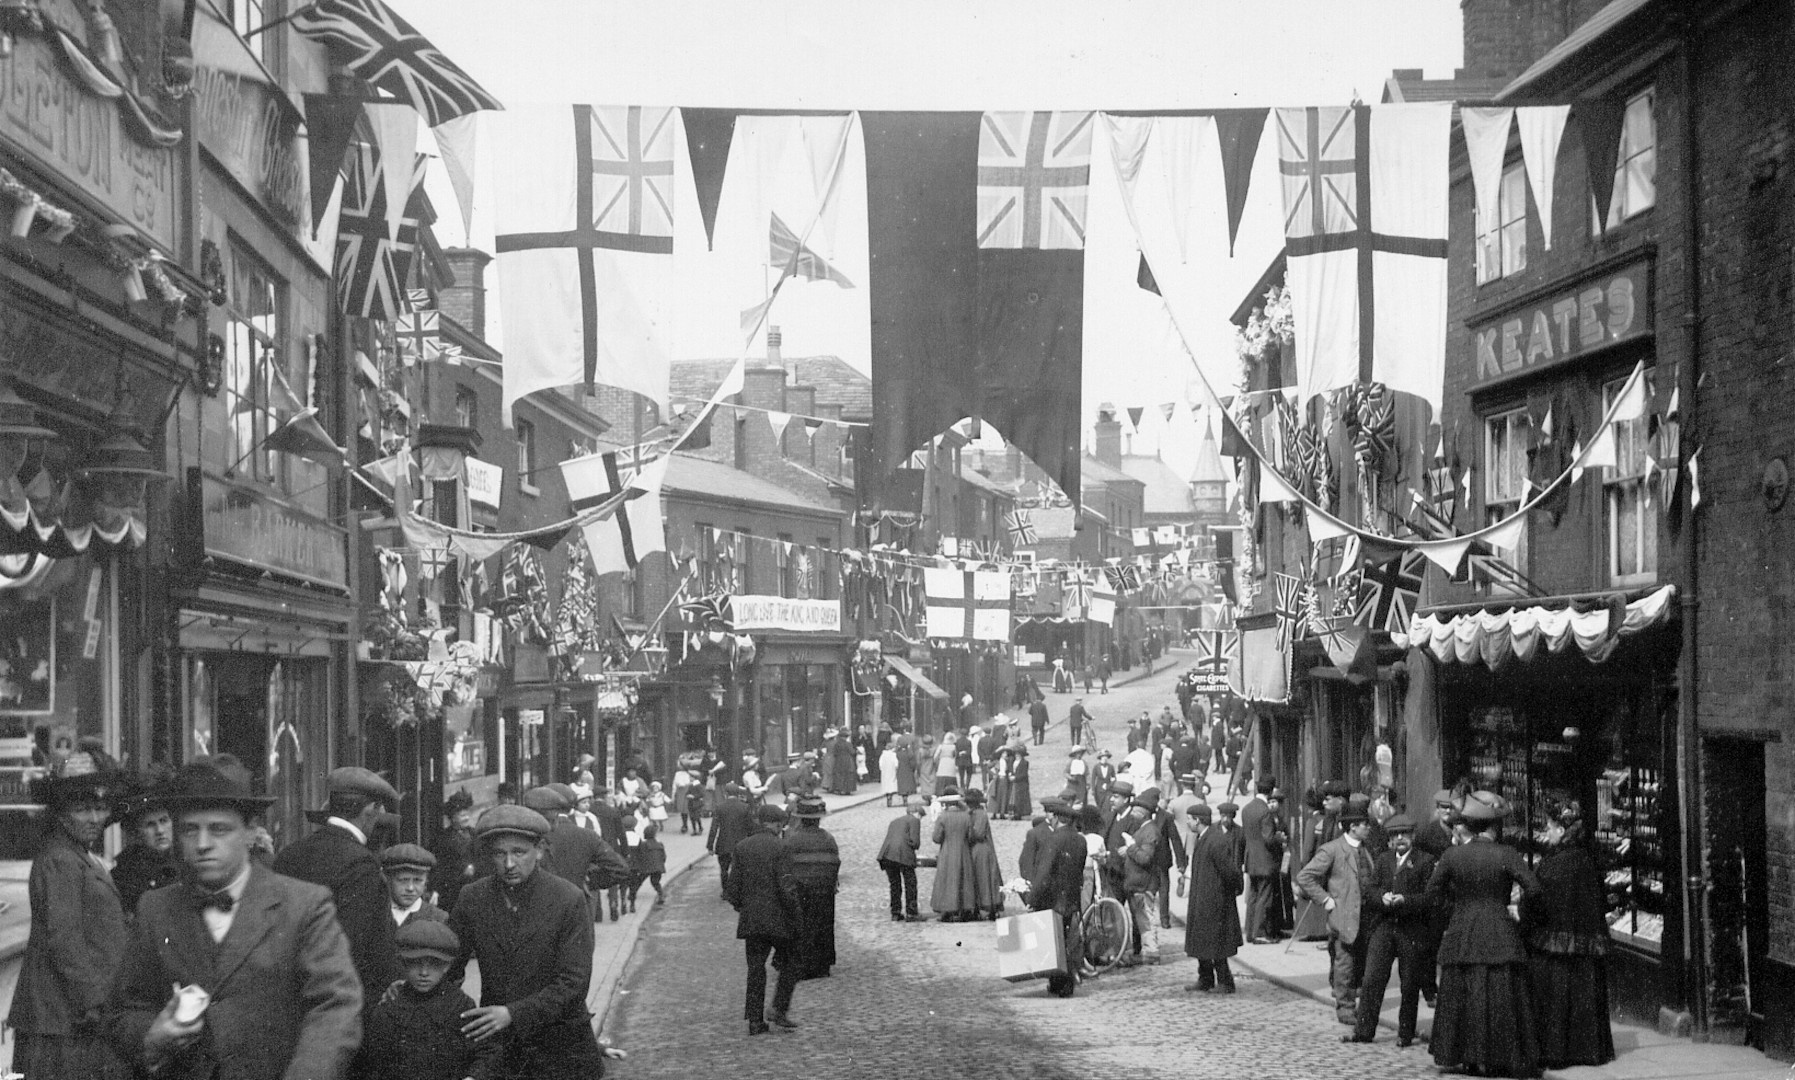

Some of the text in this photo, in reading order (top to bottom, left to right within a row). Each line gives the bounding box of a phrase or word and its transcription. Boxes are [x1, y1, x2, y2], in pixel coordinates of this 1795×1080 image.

[1476, 277, 1634, 381] KEATES
[739, 602, 838, 625] LONG LIVE THE KING AND QUEEN
